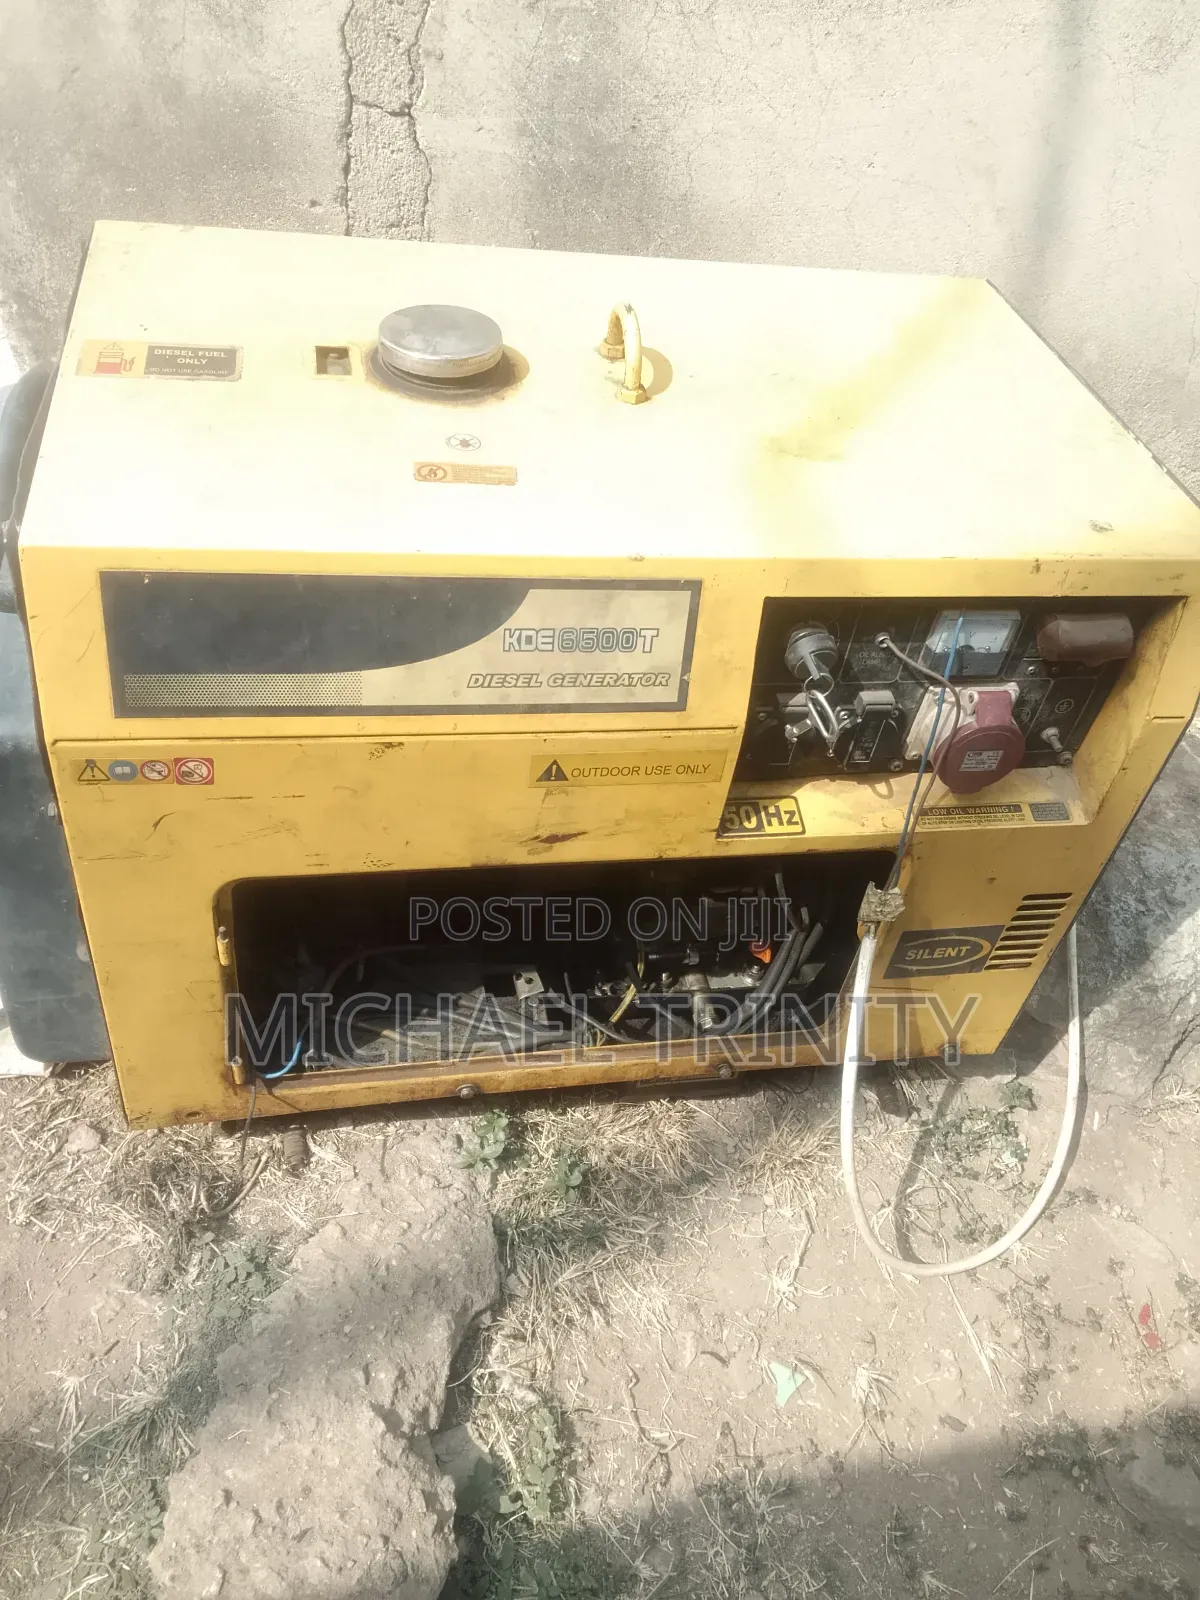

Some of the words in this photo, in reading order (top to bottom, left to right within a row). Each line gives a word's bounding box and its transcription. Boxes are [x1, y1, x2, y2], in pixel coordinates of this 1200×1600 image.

[154, 349, 194, 357] DIESEL
[177, 357, 209, 365] ONLY
[466, 673, 543, 689] DIESEL
[546, 673, 671, 688] GENERATOR
[571, 766, 640, 778] OUTDOOR
[644, 765, 672, 776] USE
[675, 764, 711, 775] ONLY
[949, 807, 964, 815] OIL
[966, 806, 1009, 814] WARNING
[905, 945, 971, 961] SILENT
